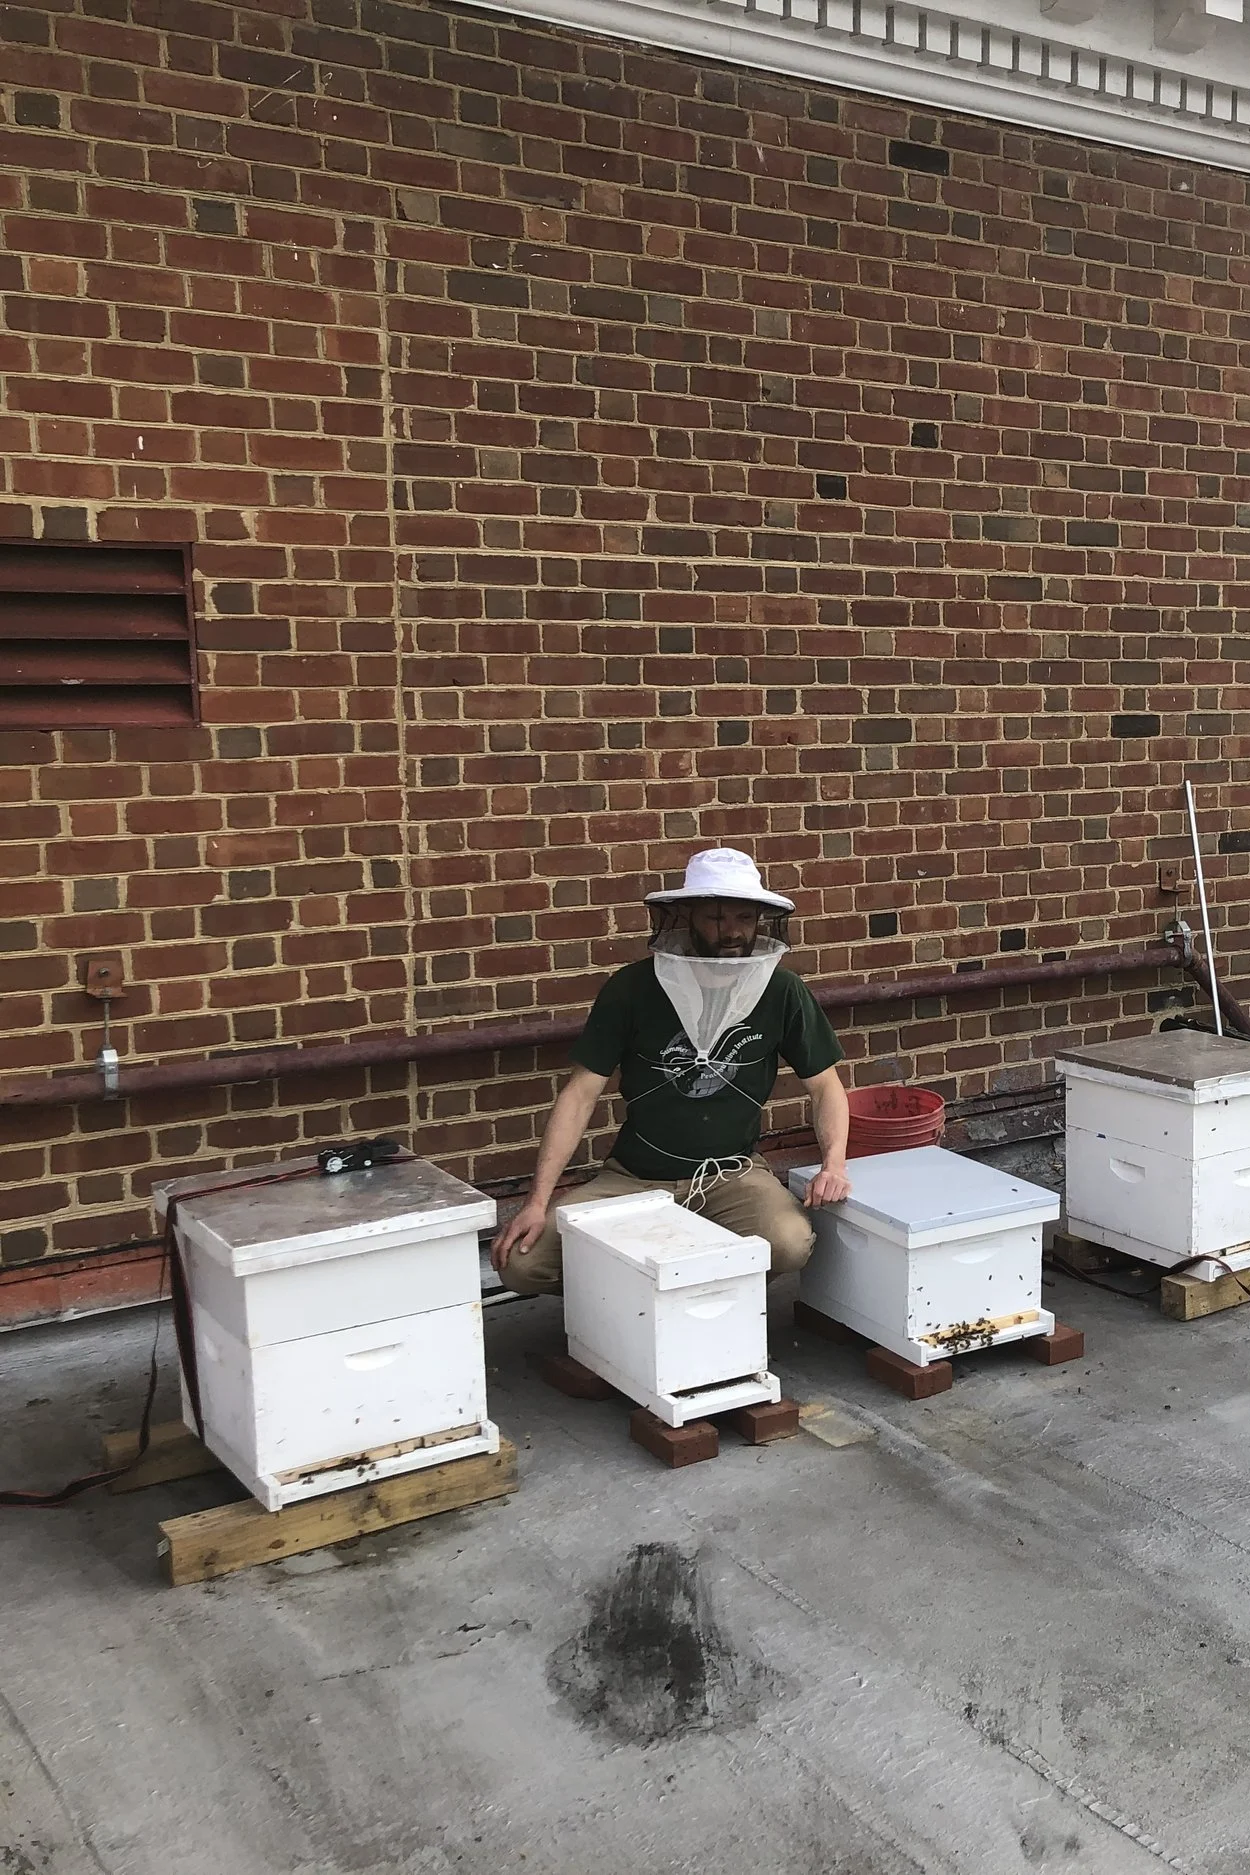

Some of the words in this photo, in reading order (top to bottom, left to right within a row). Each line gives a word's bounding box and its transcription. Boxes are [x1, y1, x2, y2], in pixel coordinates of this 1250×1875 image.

[660, 1046, 689, 1057] Summer
[700, 1048, 738, 1079] Peacbulding
[734, 1033, 763, 1050] Institute
